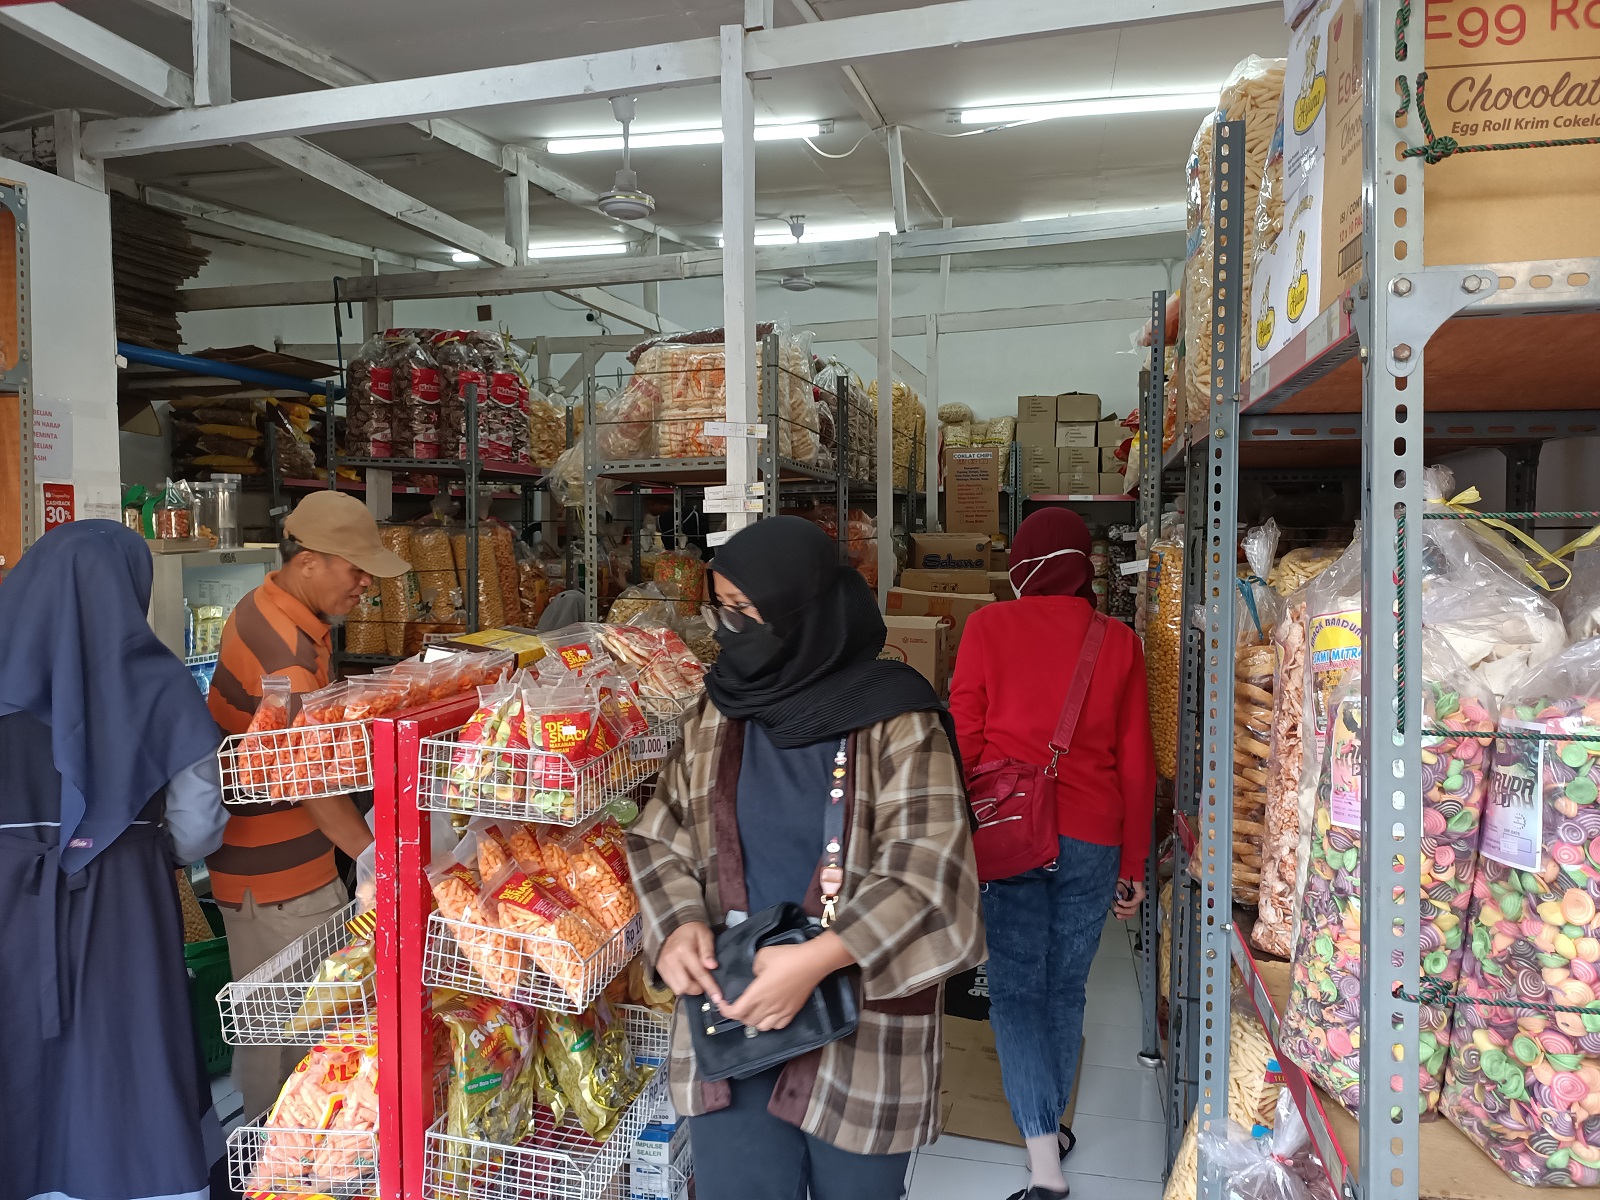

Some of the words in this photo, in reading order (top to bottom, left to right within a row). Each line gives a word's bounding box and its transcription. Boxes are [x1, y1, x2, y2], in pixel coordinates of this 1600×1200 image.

[1425, 0, 1527, 48] Egg
[1451, 121, 1479, 136] Egg
[1482, 118, 1512, 133] Roll
[1514, 117, 1550, 130] Krim
[46, 506, 72, 523] 30%
[922, 553, 985, 569] Sabena
[545, 722, 563, 733] DE
[631, 740, 639, 758] Rp
[625, 930, 635, 947] Rp
[635, 1141, 663, 1150] IMPULSE
[637, 1149, 662, 1157] SEALER
